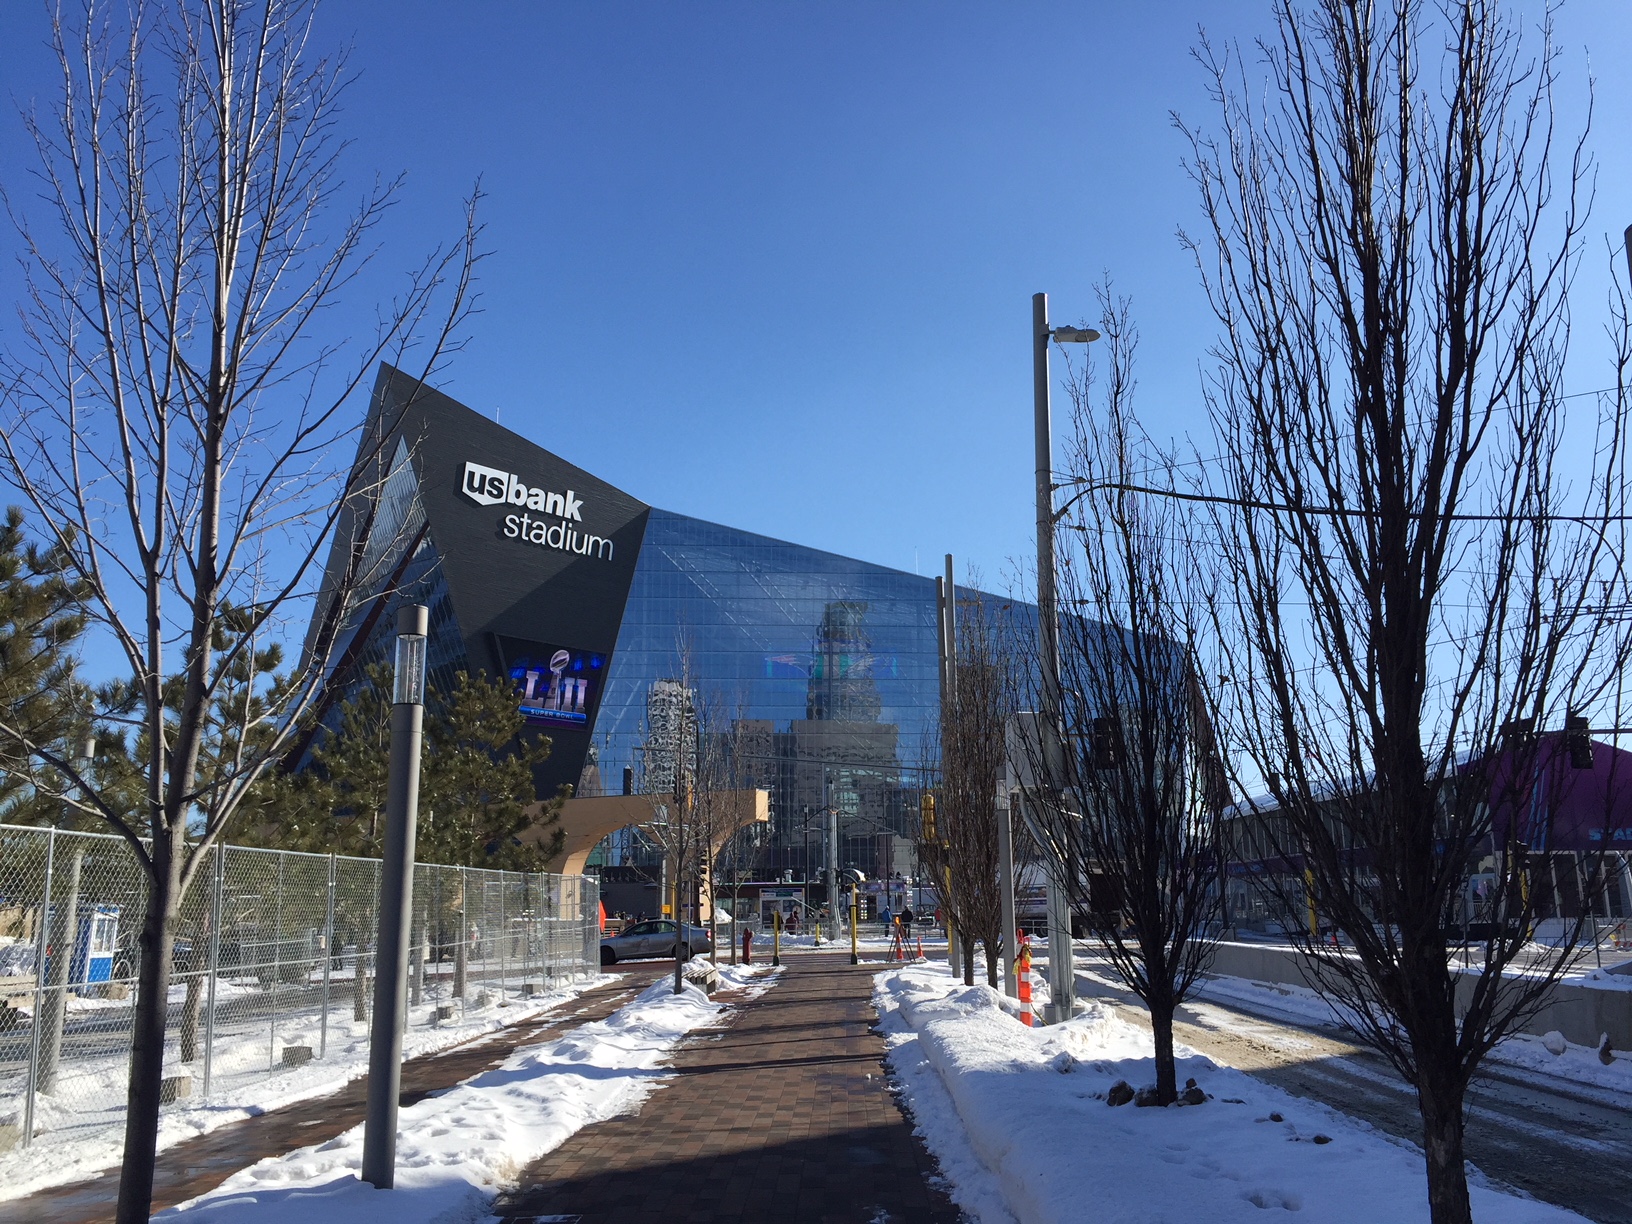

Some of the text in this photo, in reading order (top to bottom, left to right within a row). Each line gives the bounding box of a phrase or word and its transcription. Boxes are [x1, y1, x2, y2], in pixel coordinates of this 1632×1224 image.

[503, 512, 614, 561] stadium
[530, 709, 574, 719] SUPER BOWL
